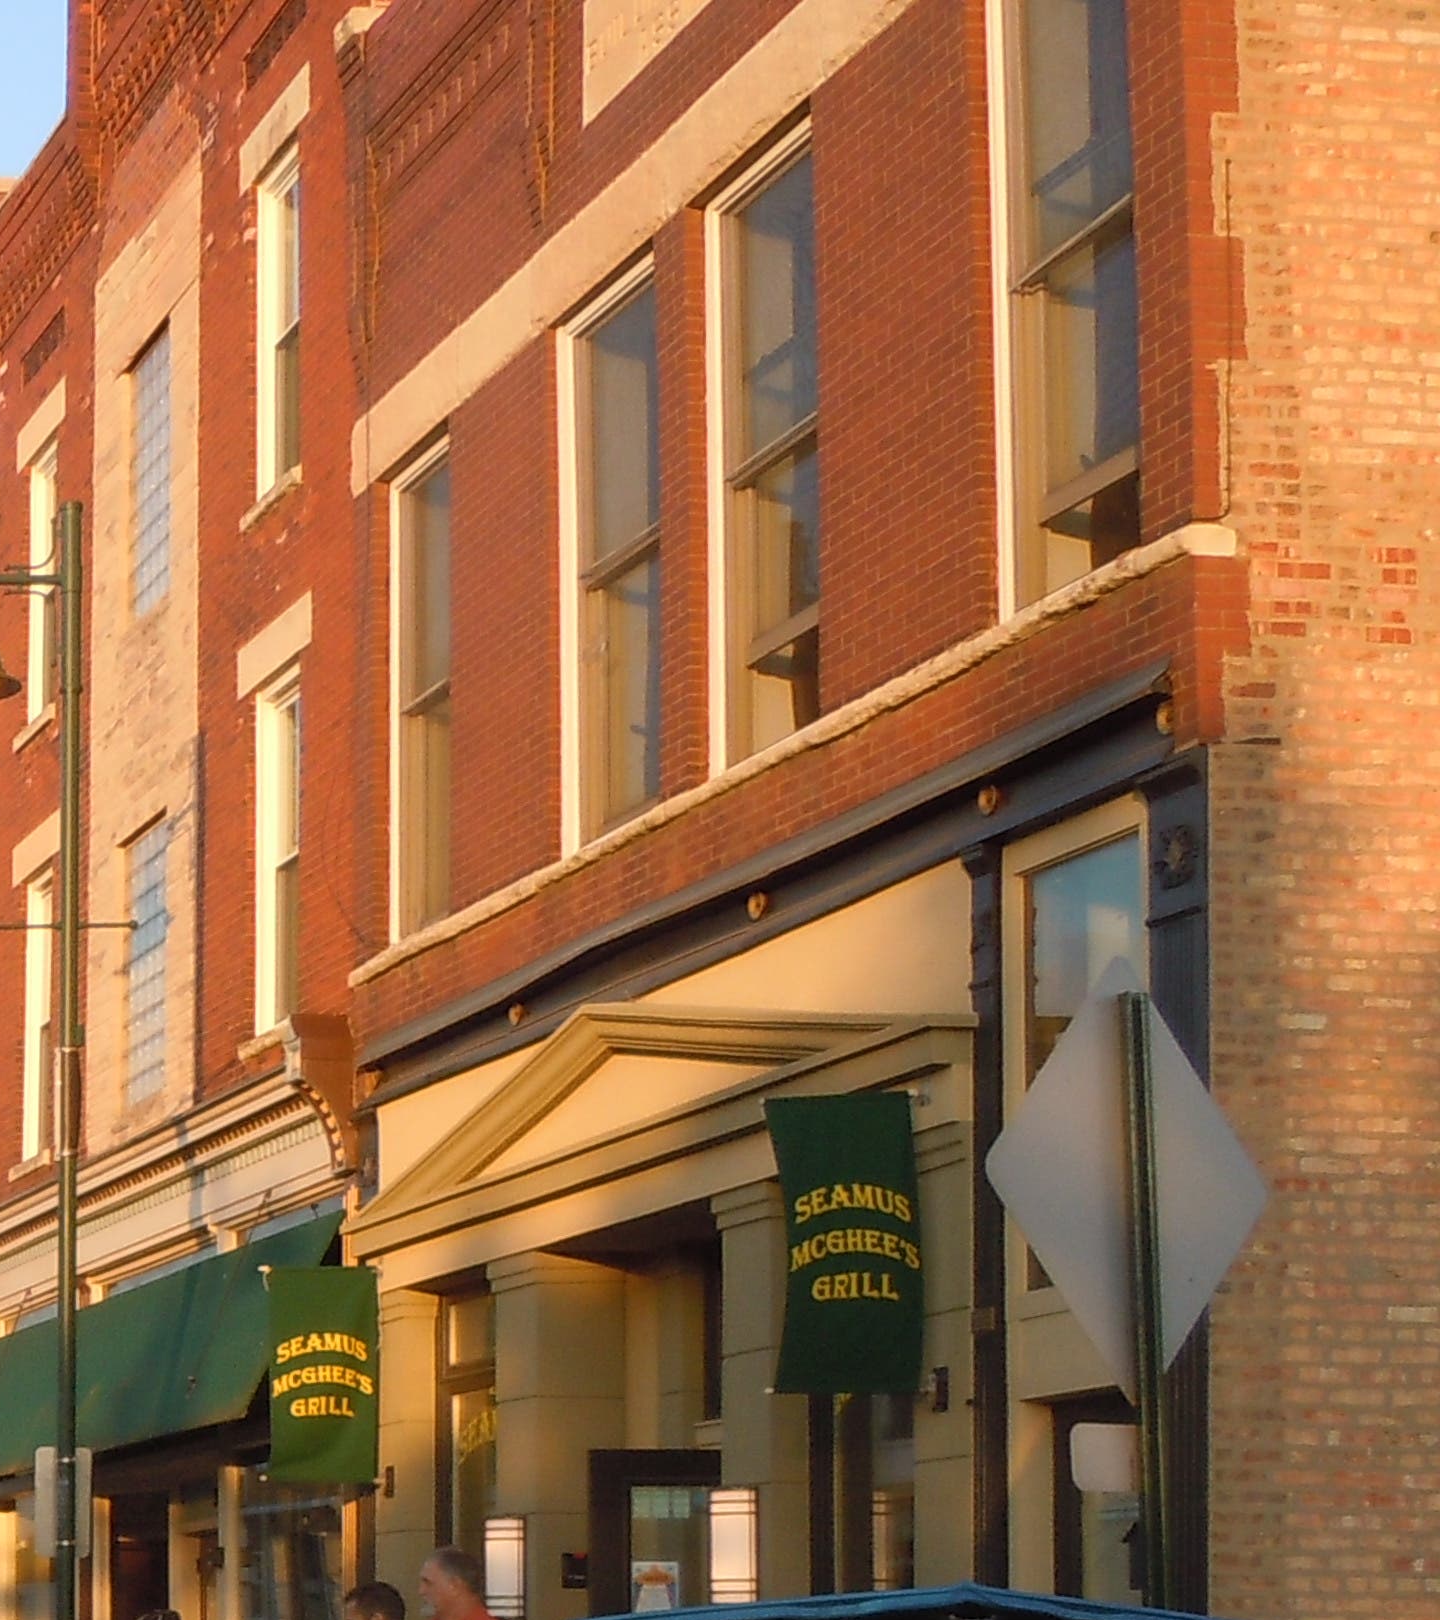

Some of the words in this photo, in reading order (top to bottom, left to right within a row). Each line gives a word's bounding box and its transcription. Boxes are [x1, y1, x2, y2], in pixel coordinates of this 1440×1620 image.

[794, 1183, 912, 1225] SEAMUS
[789, 1228, 921, 1273] MCGHEE'S
[811, 1272, 900, 1301] GRILL
[275, 1332, 368, 1365] SEAMUS
[271, 1364, 375, 1398] MCGHEE'S
[289, 1396, 356, 1419] GRILL
